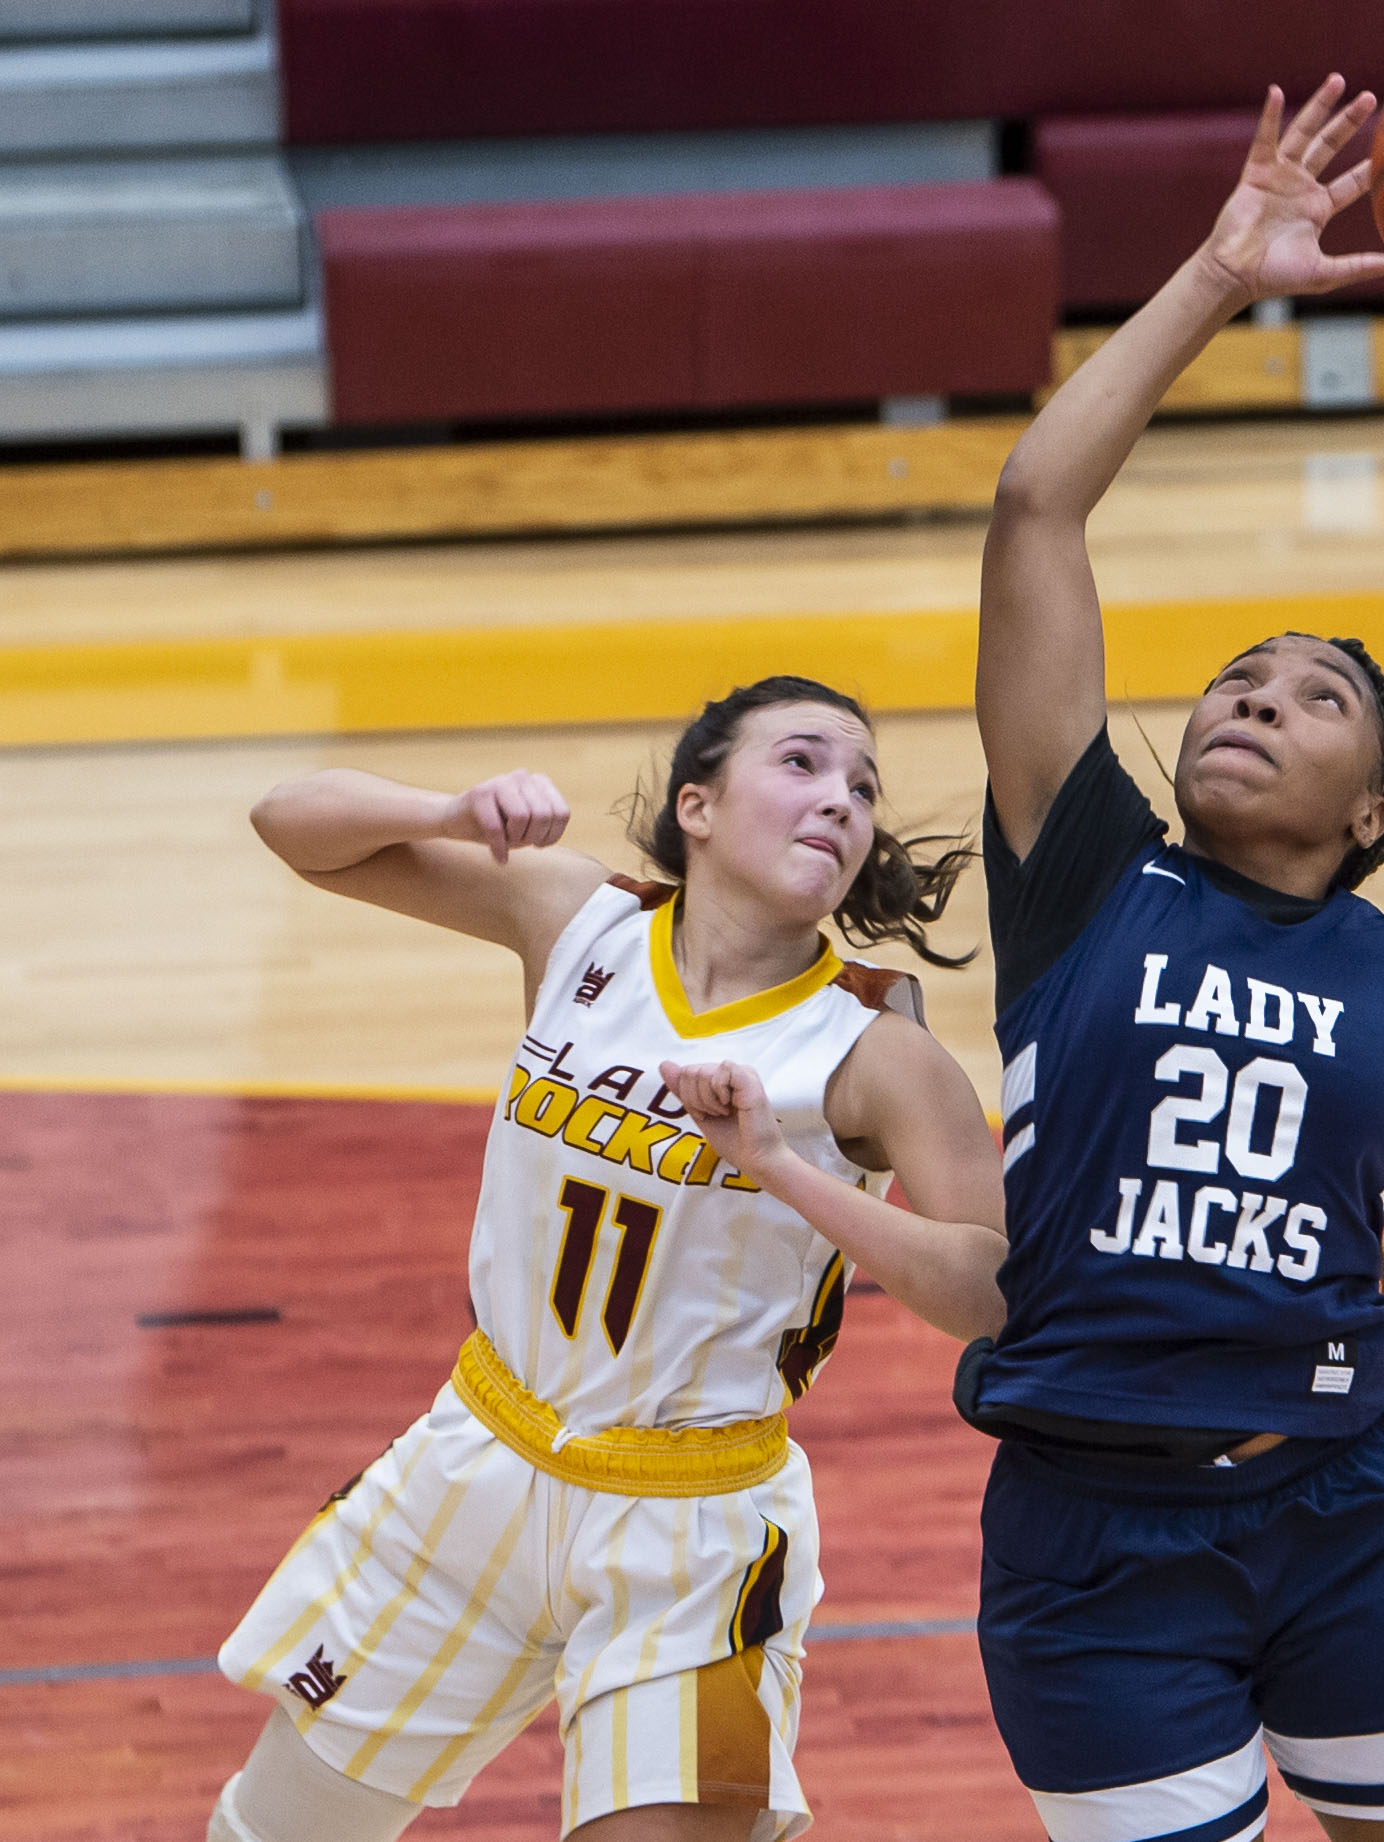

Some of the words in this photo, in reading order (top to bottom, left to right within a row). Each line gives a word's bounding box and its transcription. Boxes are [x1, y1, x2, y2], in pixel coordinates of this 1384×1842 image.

[1134, 953, 1345, 1057] LADY
[547, 1041, 690, 1119] LAD
[1147, 1043, 1309, 1182] 20
[549, 1174, 664, 1358] 11
[1089, 1177, 1328, 1282] JACKS
[1327, 1341, 1345, 1361] M
